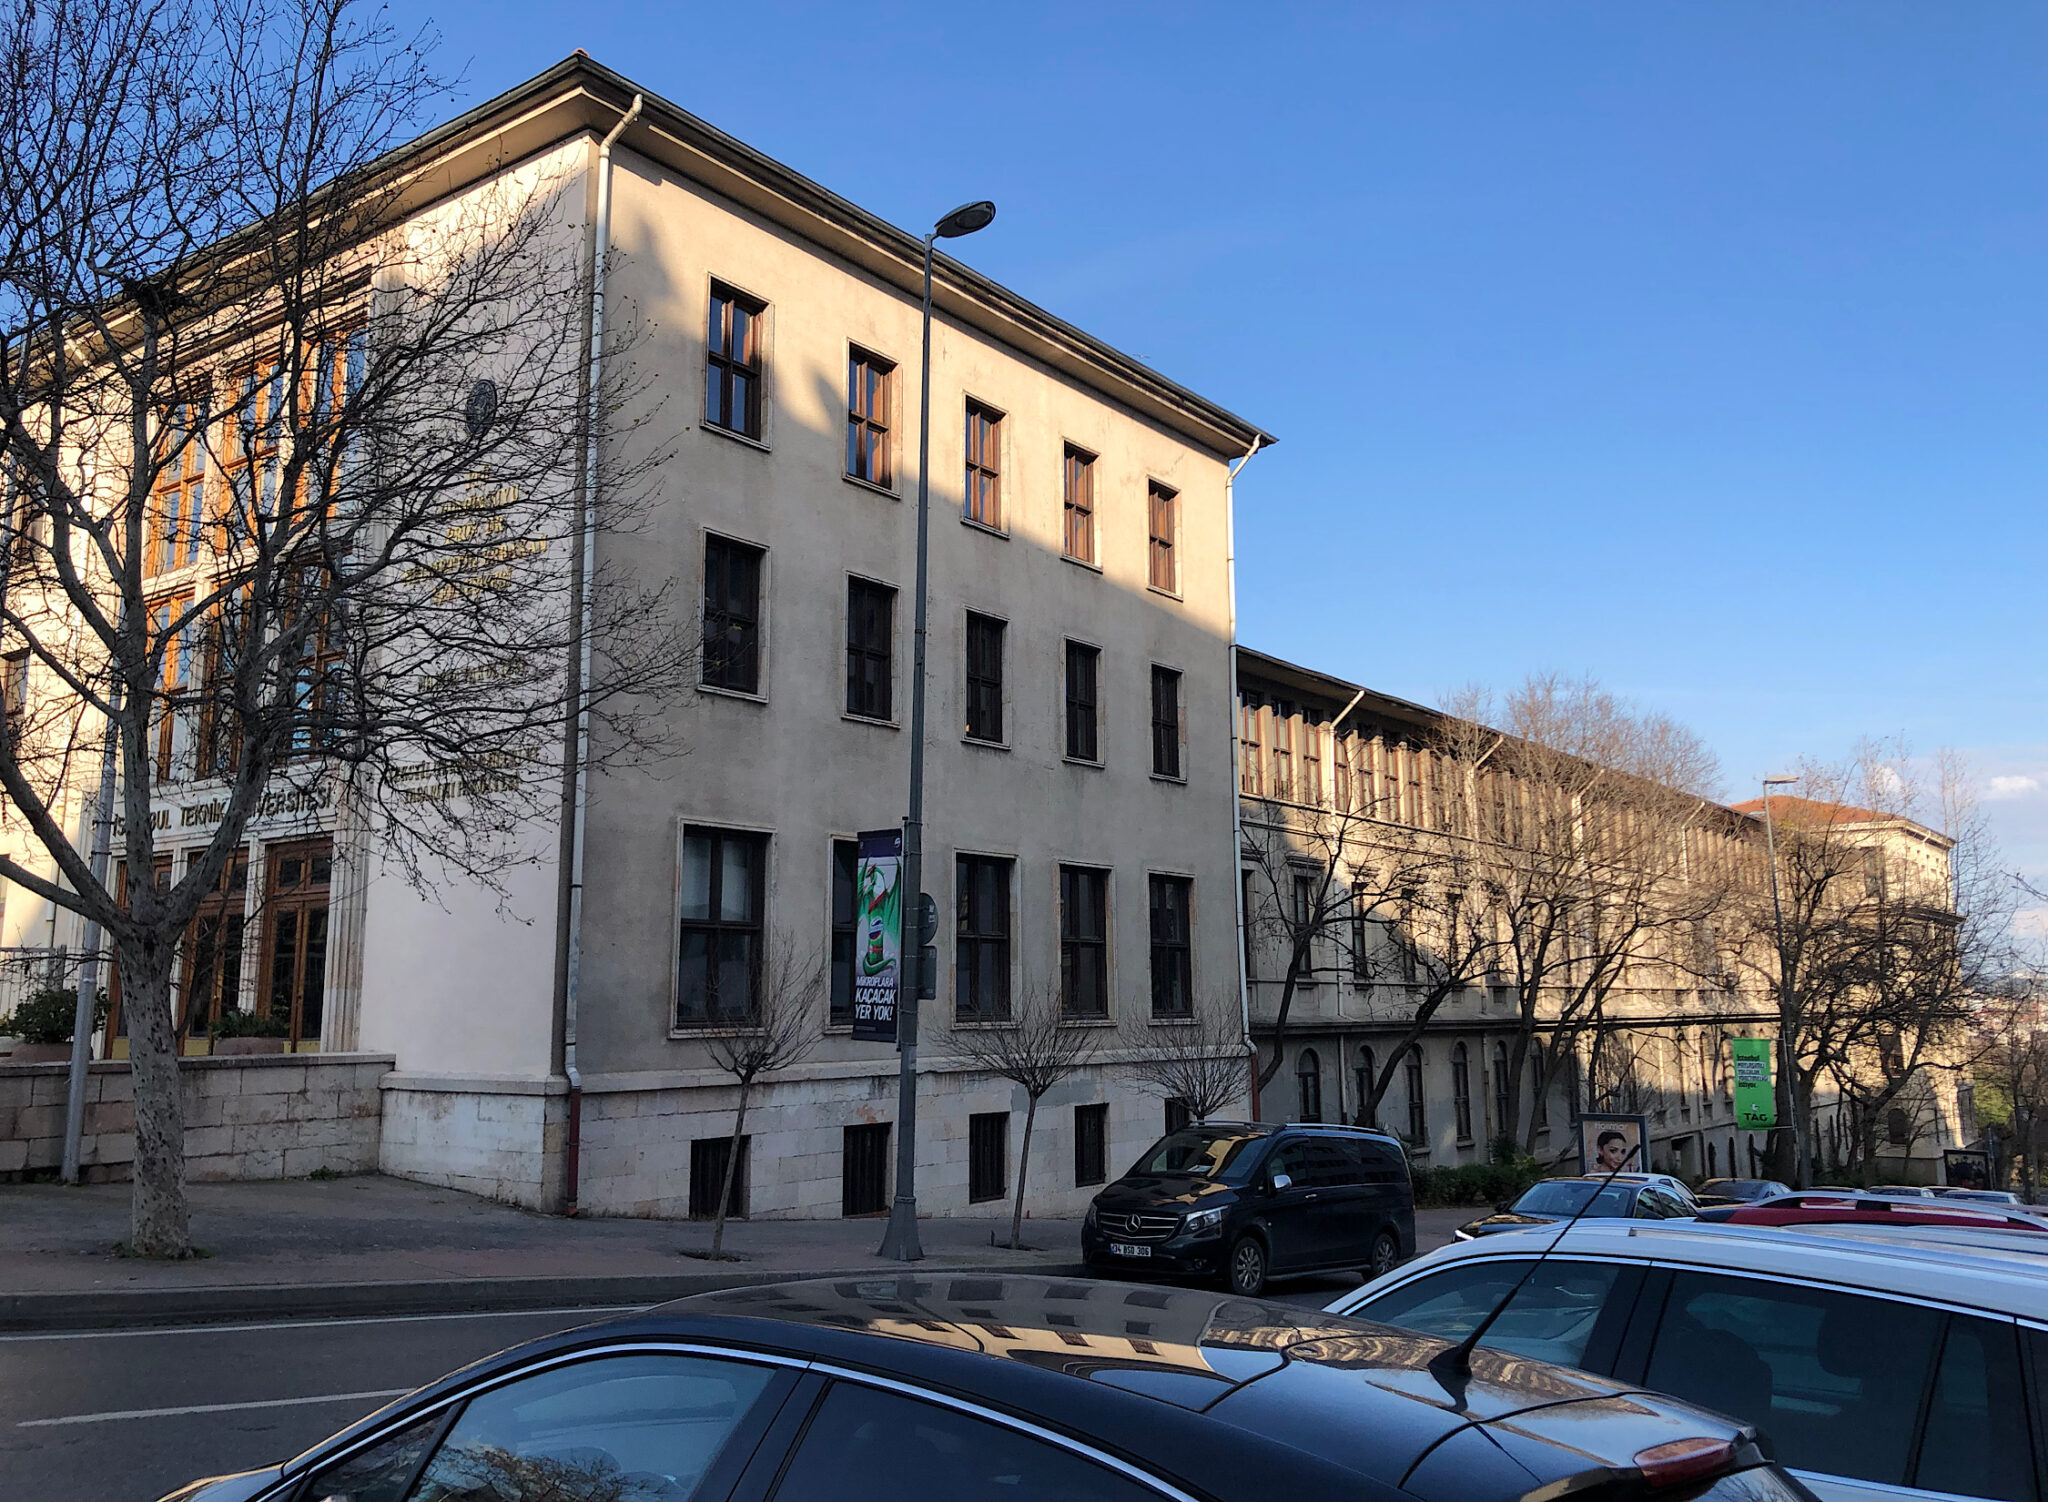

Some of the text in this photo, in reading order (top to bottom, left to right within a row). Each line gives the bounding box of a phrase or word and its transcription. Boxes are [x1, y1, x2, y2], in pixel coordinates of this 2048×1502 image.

[855, 1004, 894, 1021] YER YOK!
[1744, 1113, 1768, 1122] TAG
